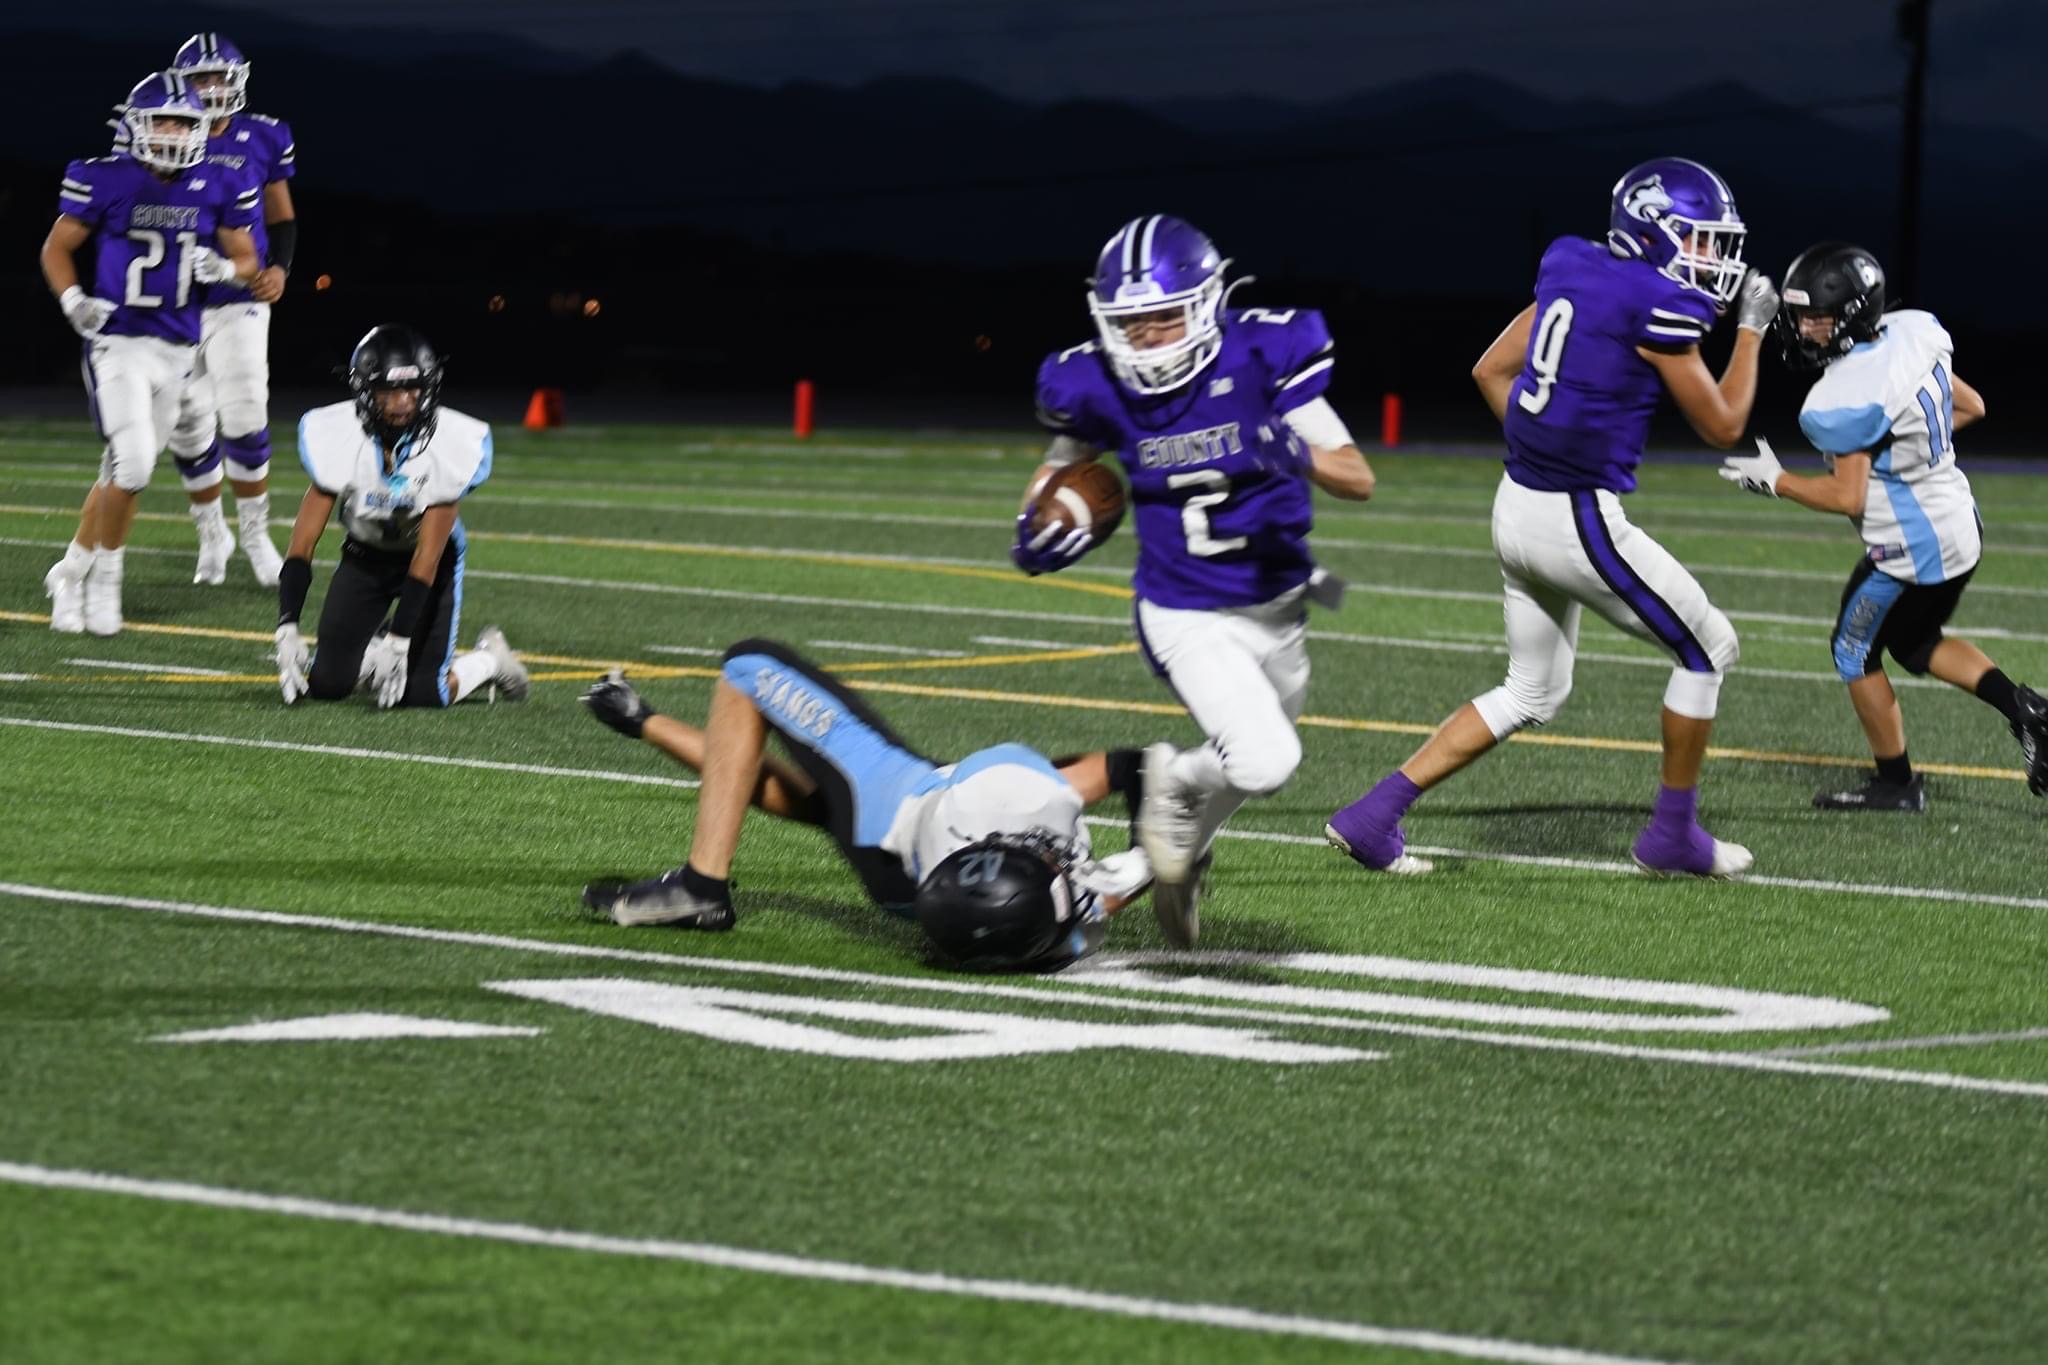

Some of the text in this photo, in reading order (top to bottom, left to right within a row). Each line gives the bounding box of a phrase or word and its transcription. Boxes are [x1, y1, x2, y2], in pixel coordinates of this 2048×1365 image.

[132, 204, 200, 229] COUNTY
[125, 229, 197, 308] 21
[1518, 297, 1574, 414] 9
[1136, 421, 1243, 468] COUNTY
[1167, 469, 1247, 556] 2
